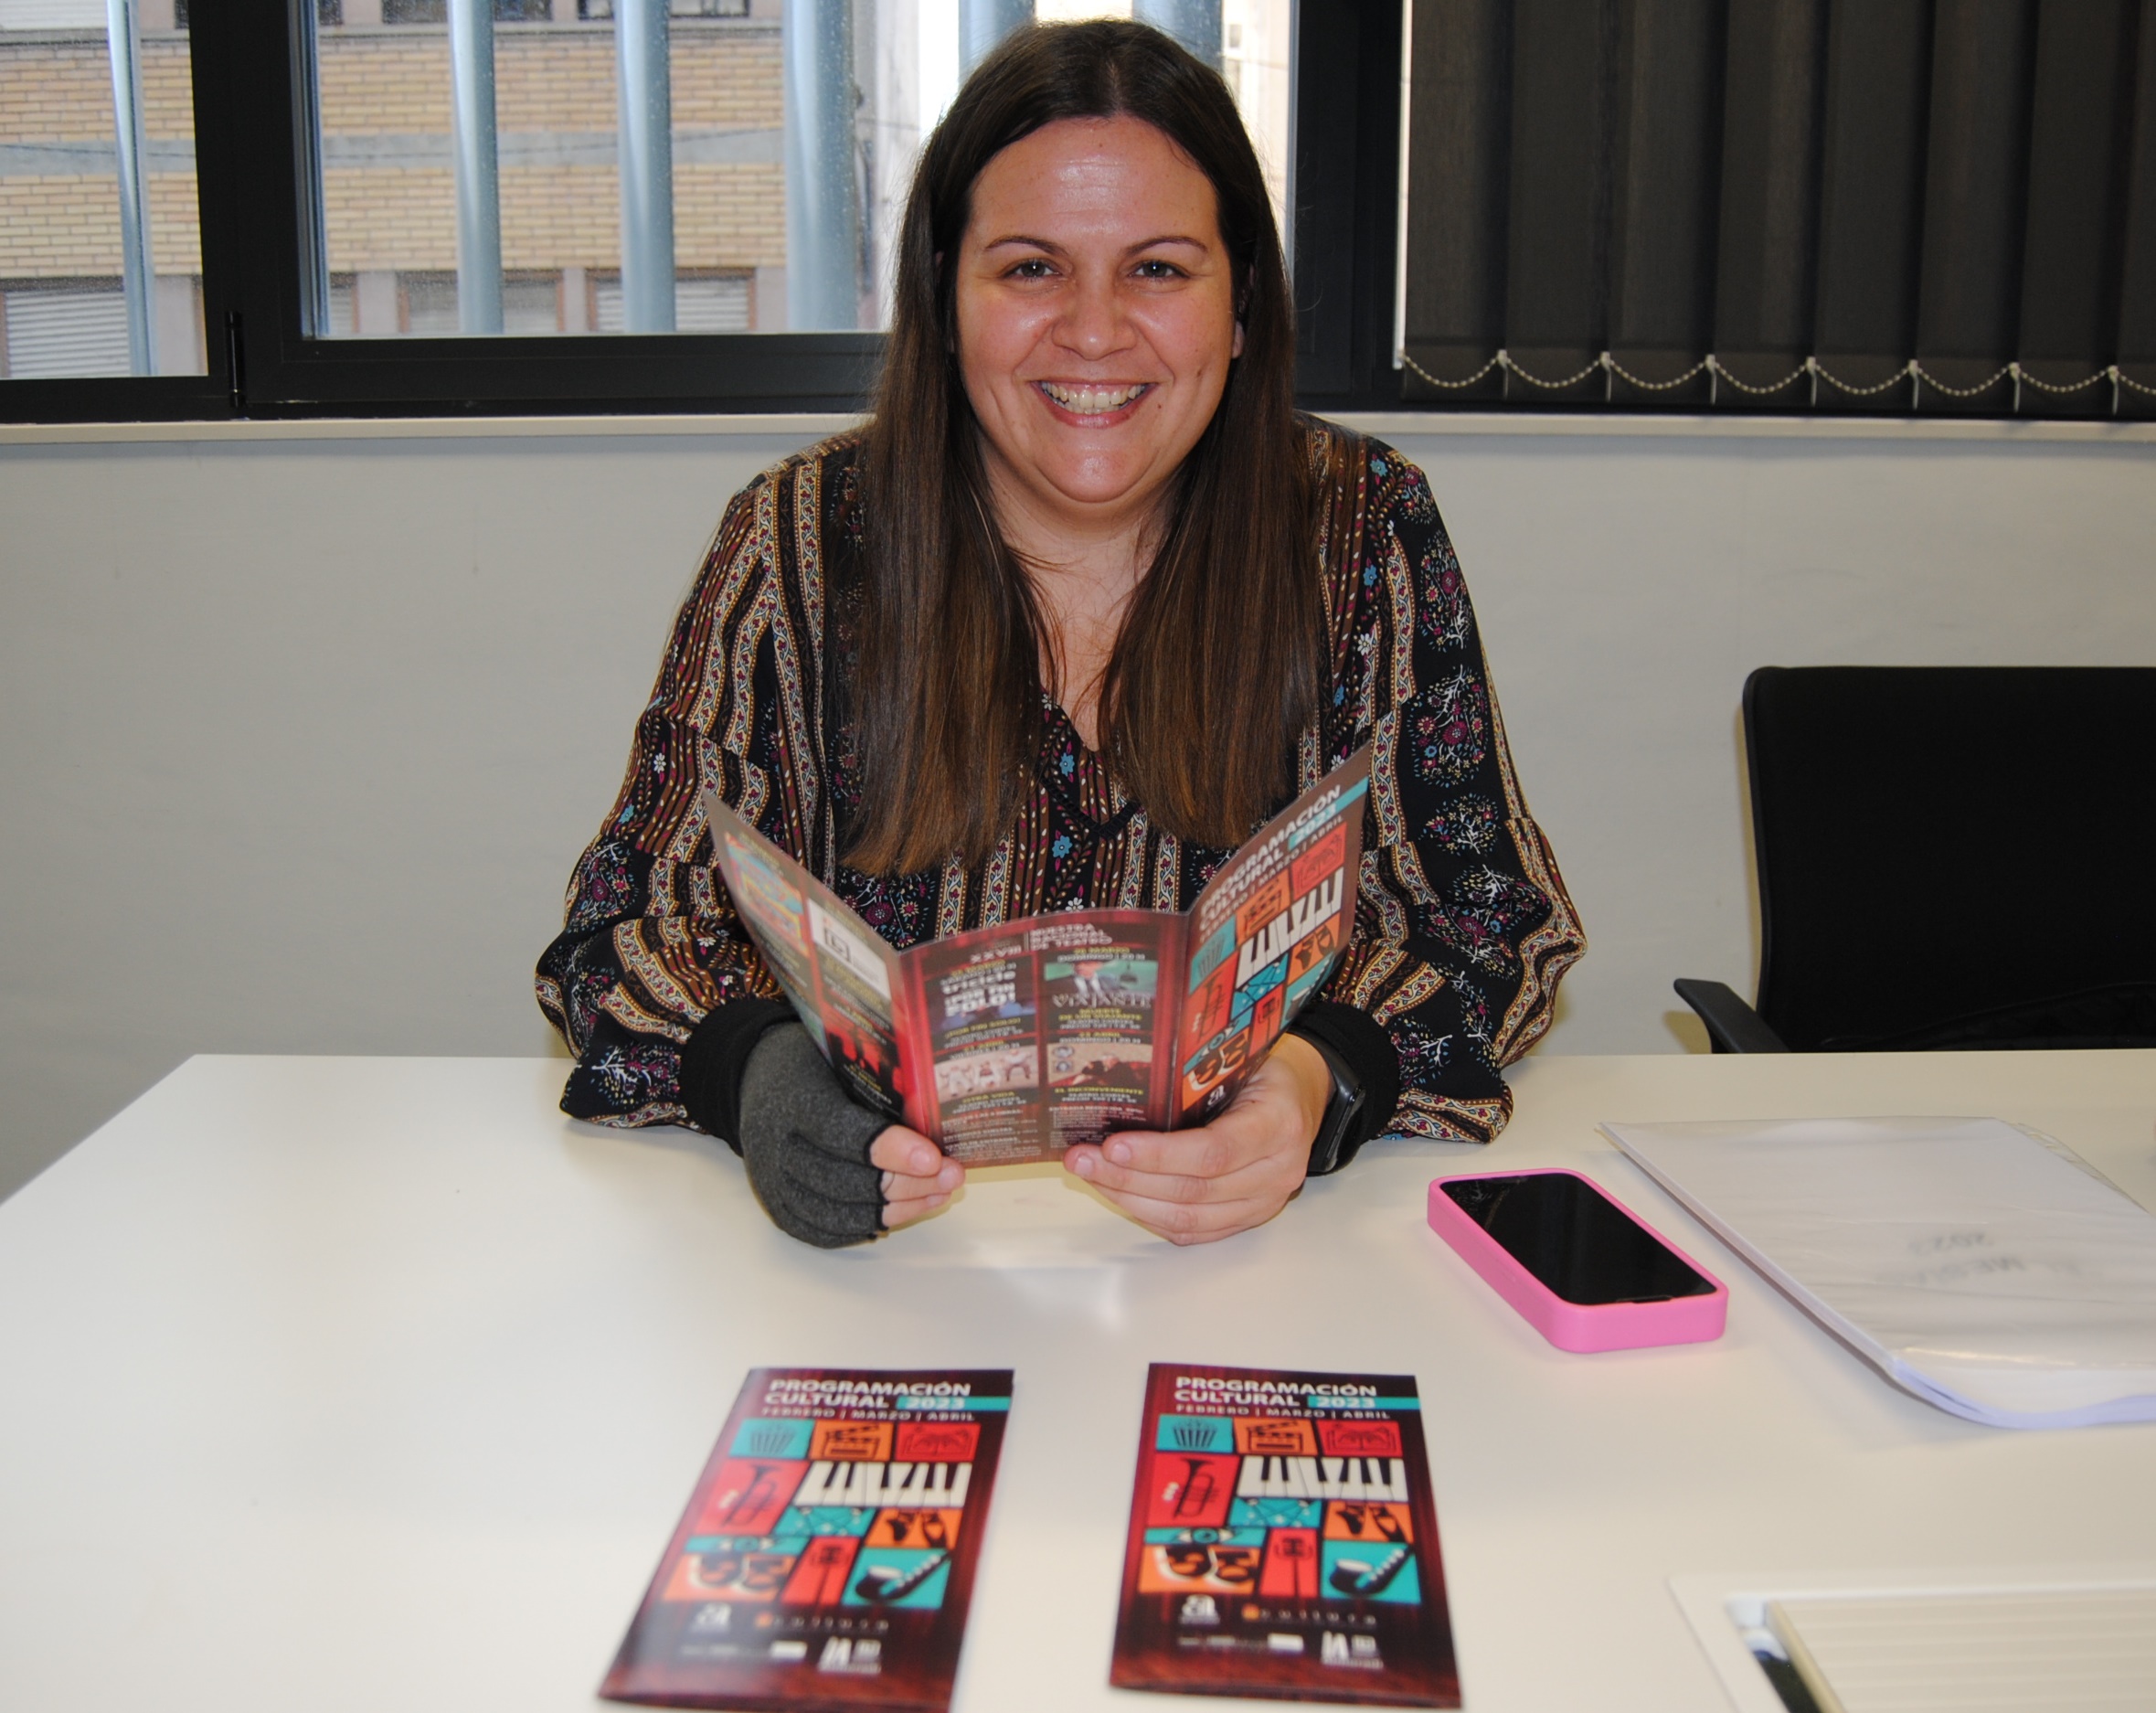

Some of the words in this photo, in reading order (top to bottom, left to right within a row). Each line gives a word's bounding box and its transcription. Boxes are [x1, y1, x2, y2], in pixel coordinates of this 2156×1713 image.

[1200, 784, 1341, 917] PROGRAMACIÓN
[1259, 851, 1300, 887] MARZO
[1310, 816, 1344, 844] ABRIL
[1199, 850, 1284, 931] CULTURAL
[1294, 803, 1337, 844] 2023
[769, 1378, 971, 1397] PROGRAMACIÓN
[1175, 1376, 1377, 1397] PROGRAMACIÓN
[764, 1392, 888, 1409] CULTURAL
[905, 1397, 965, 1410] 2023
[1174, 1389, 1300, 1407] CULTURAL
[1316, 1396, 1376, 1409] 2023
[760, 1407, 835, 1419] FEBRERO
[851, 1410, 910, 1420] MARZO
[927, 1410, 975, 1421] ABRIL
[1175, 1405, 1249, 1416] FEBRERO
[1266, 1407, 1325, 1418] MARZO
[1343, 1410, 1390, 1420] ABRIL
